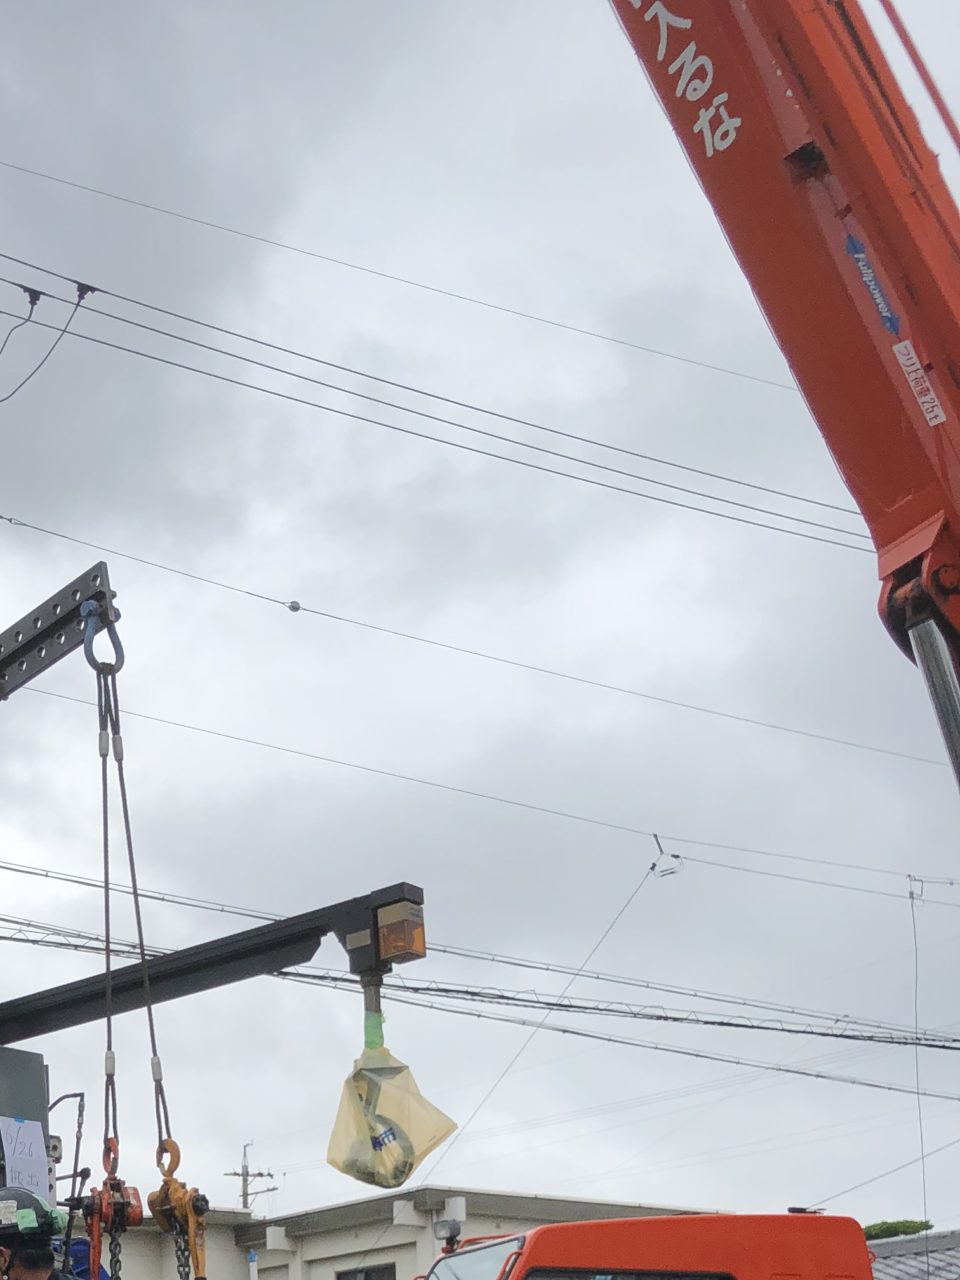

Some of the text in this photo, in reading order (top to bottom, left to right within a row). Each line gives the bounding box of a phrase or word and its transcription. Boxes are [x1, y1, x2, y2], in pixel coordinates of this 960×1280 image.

[630, 0, 742, 158] 入るな
[854, 252, 891, 319] Fullpower
